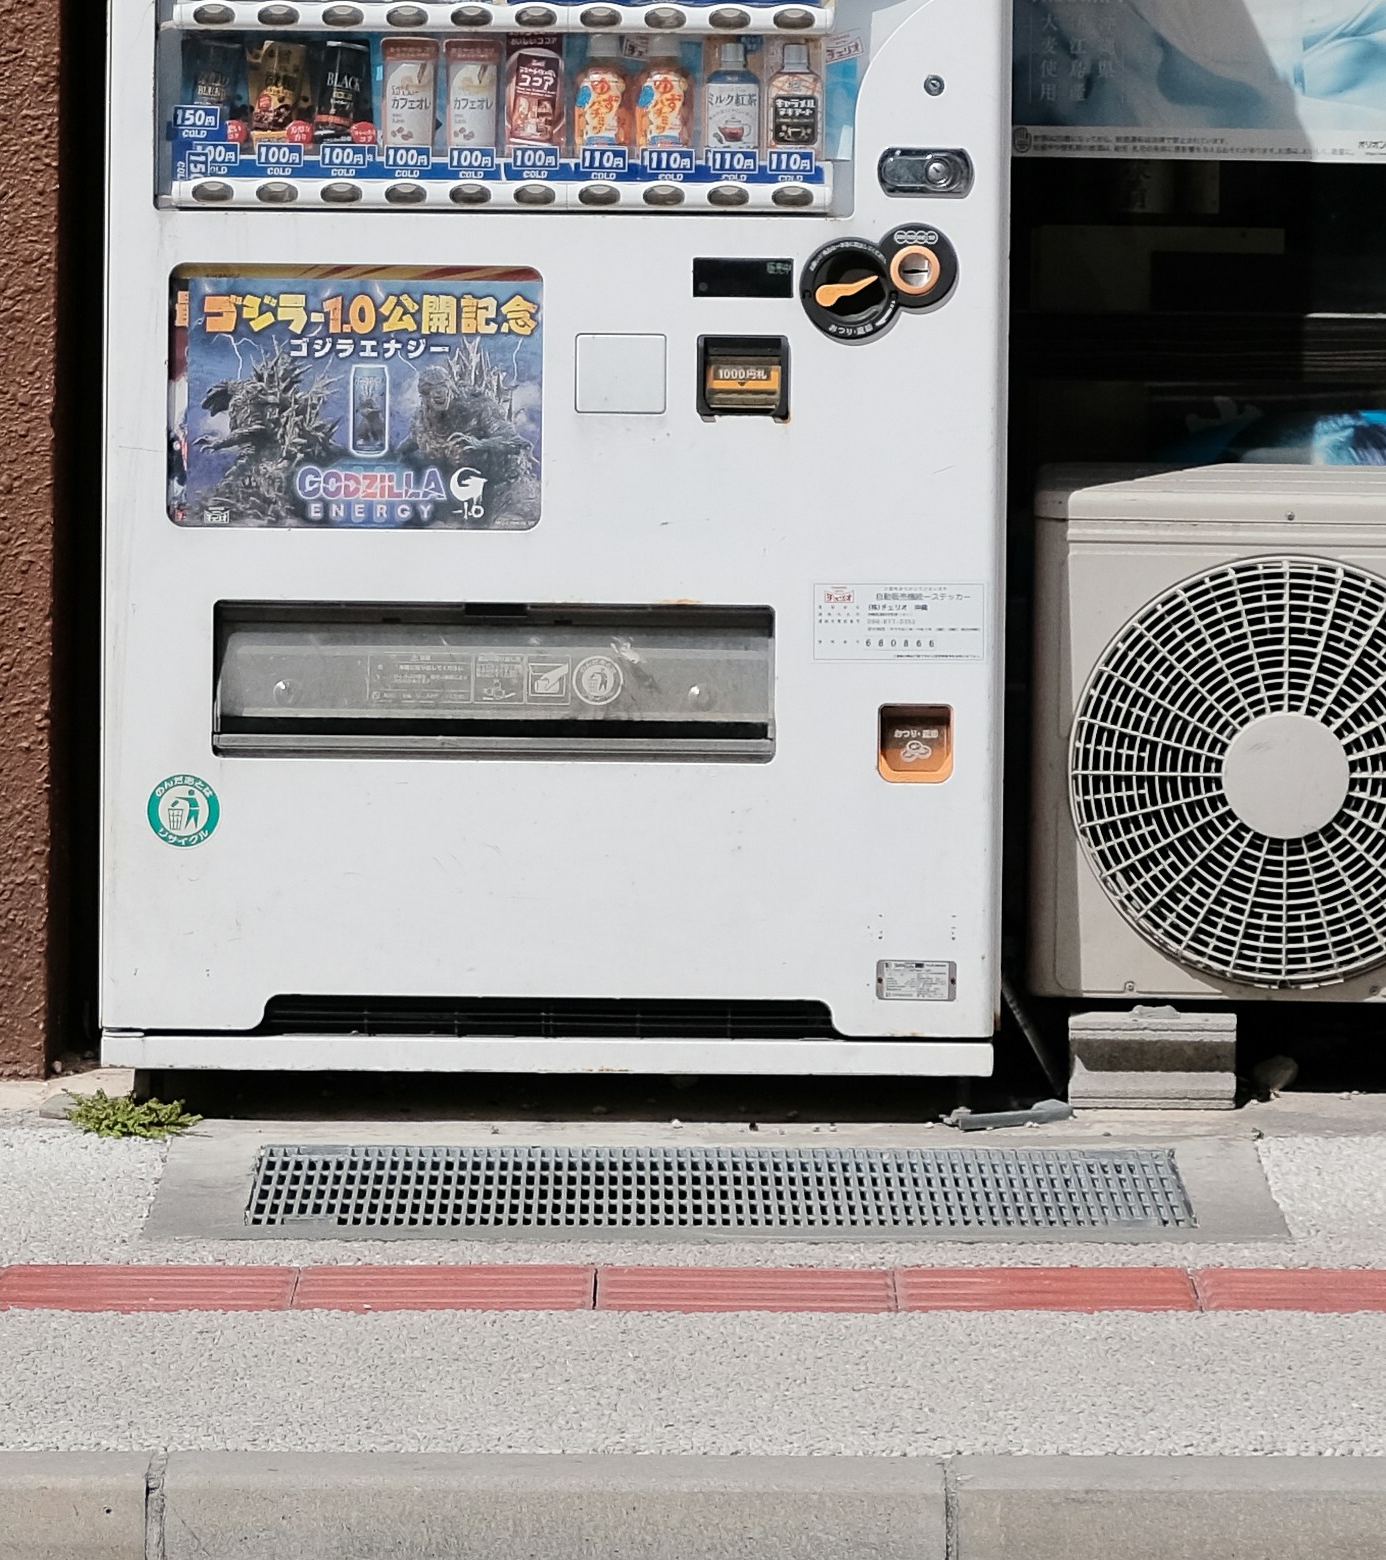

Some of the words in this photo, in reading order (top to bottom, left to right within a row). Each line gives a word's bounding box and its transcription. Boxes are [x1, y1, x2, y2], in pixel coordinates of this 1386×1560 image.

[326, 71, 361, 92] BLACK
[518, 74, 555, 91] ココア
[391, 96, 432, 110] カフェオレ
[453, 96, 493, 110] カフェオレ
[708, 92, 758, 108] ミルク紅茶
[176, 109, 216, 126] 150円
[584, 151, 624, 168] 110円
[203, 292, 539, 336] ゴジラ-1.0公開記念
[288, 337, 451, 360] ゴジラエナジー
[718, 368, 768, 380] 1000円札
[296, 465, 448, 502] GODZILLA
[310, 502, 436, 520] ENERGY
[158, 827, 210, 847] リサイクル
